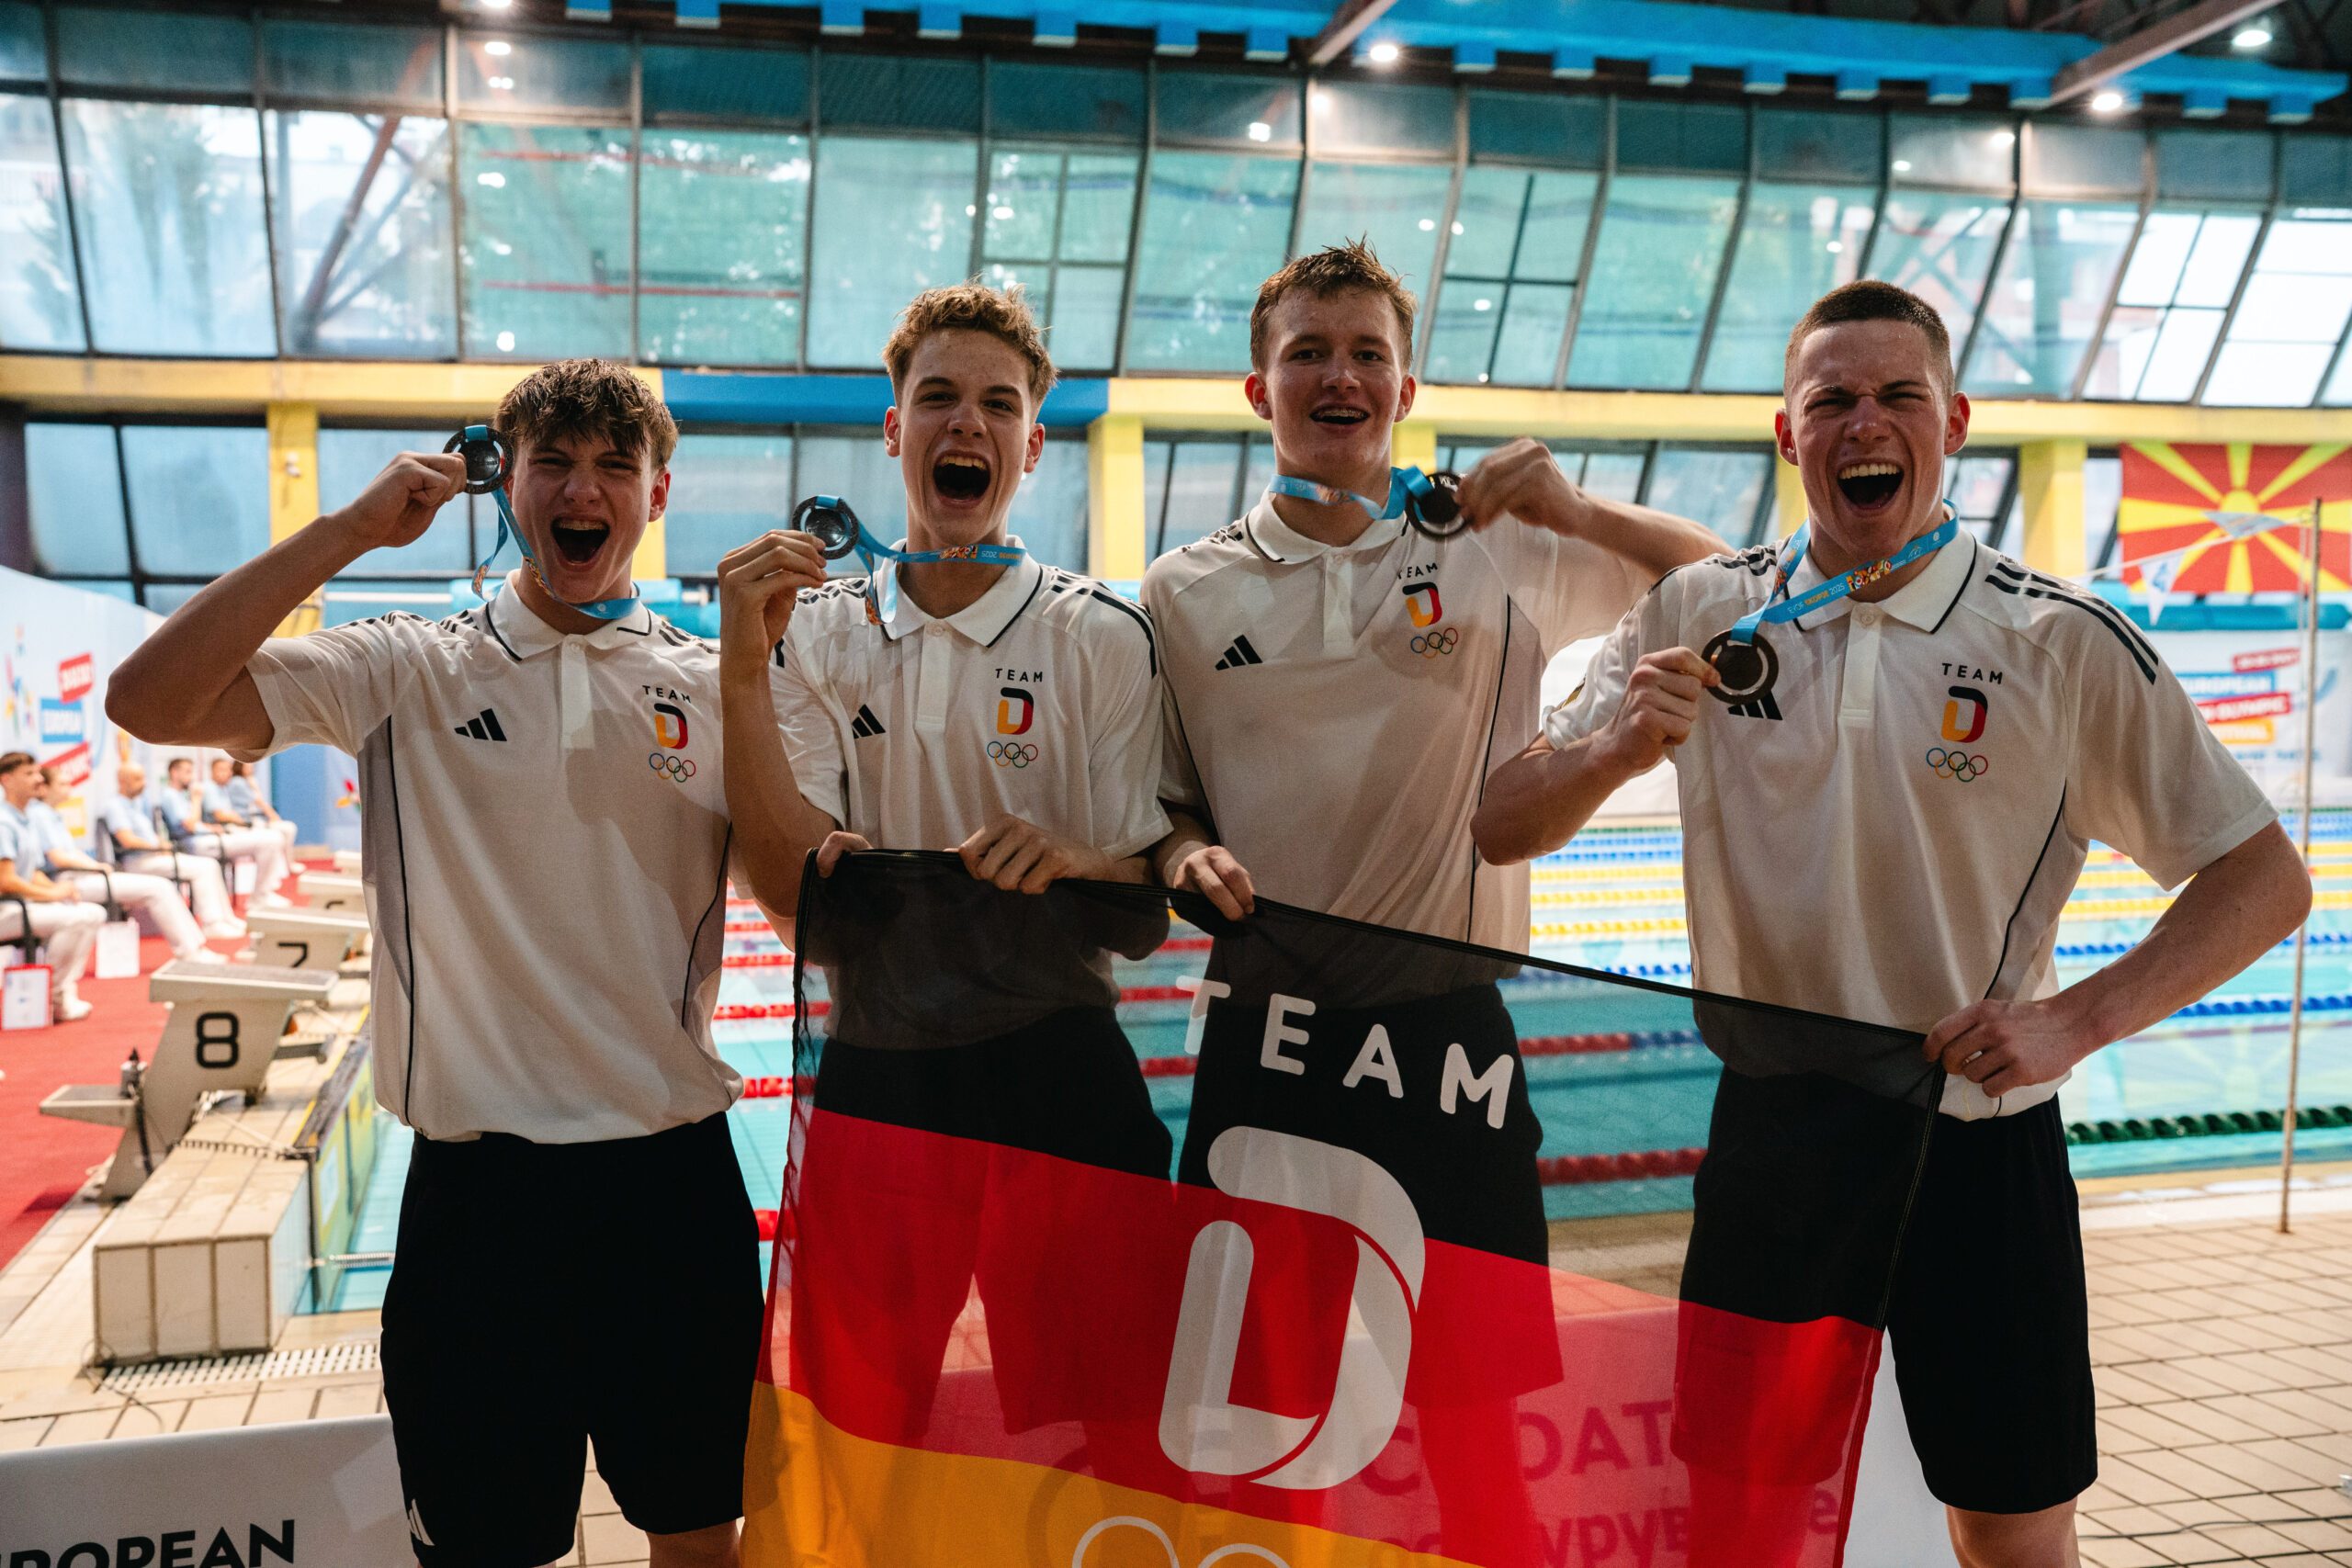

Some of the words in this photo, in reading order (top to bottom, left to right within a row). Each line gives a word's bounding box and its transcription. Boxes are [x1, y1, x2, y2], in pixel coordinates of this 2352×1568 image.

[1397, 562, 1438, 580] TEAM
[1828, 582, 1845, 595] 2025
[995, 668, 1043, 682] TEAM
[1941, 662, 2003, 685] TEAM
[642, 684, 691, 704] TEAM
[277, 942, 308, 968] 7
[196, 1011, 239, 1069] 8
[1175, 975, 1514, 1130] TEAM
